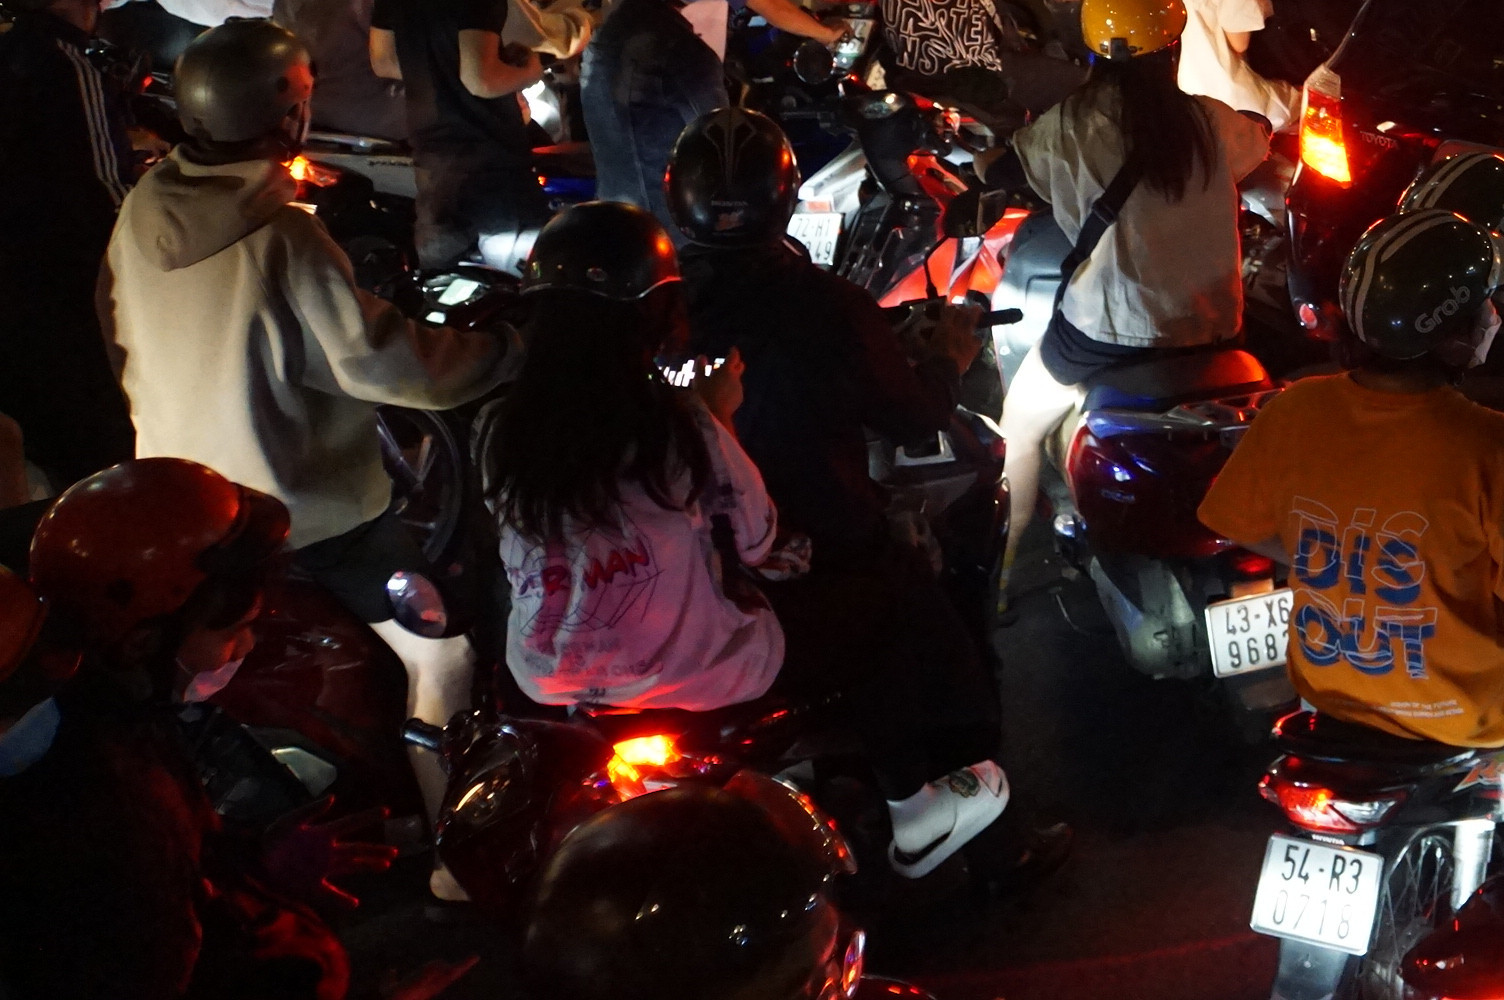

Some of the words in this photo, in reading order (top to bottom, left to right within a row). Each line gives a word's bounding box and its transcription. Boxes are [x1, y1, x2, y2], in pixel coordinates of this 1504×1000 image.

[1414, 285, 1471, 334] Grab
[1224, 596, 1292, 636] 43-X6
[1227, 629, 1291, 669] 968
[1281, 843, 1363, 896] 54-R3
[1272, 888, 1353, 941] 0718
